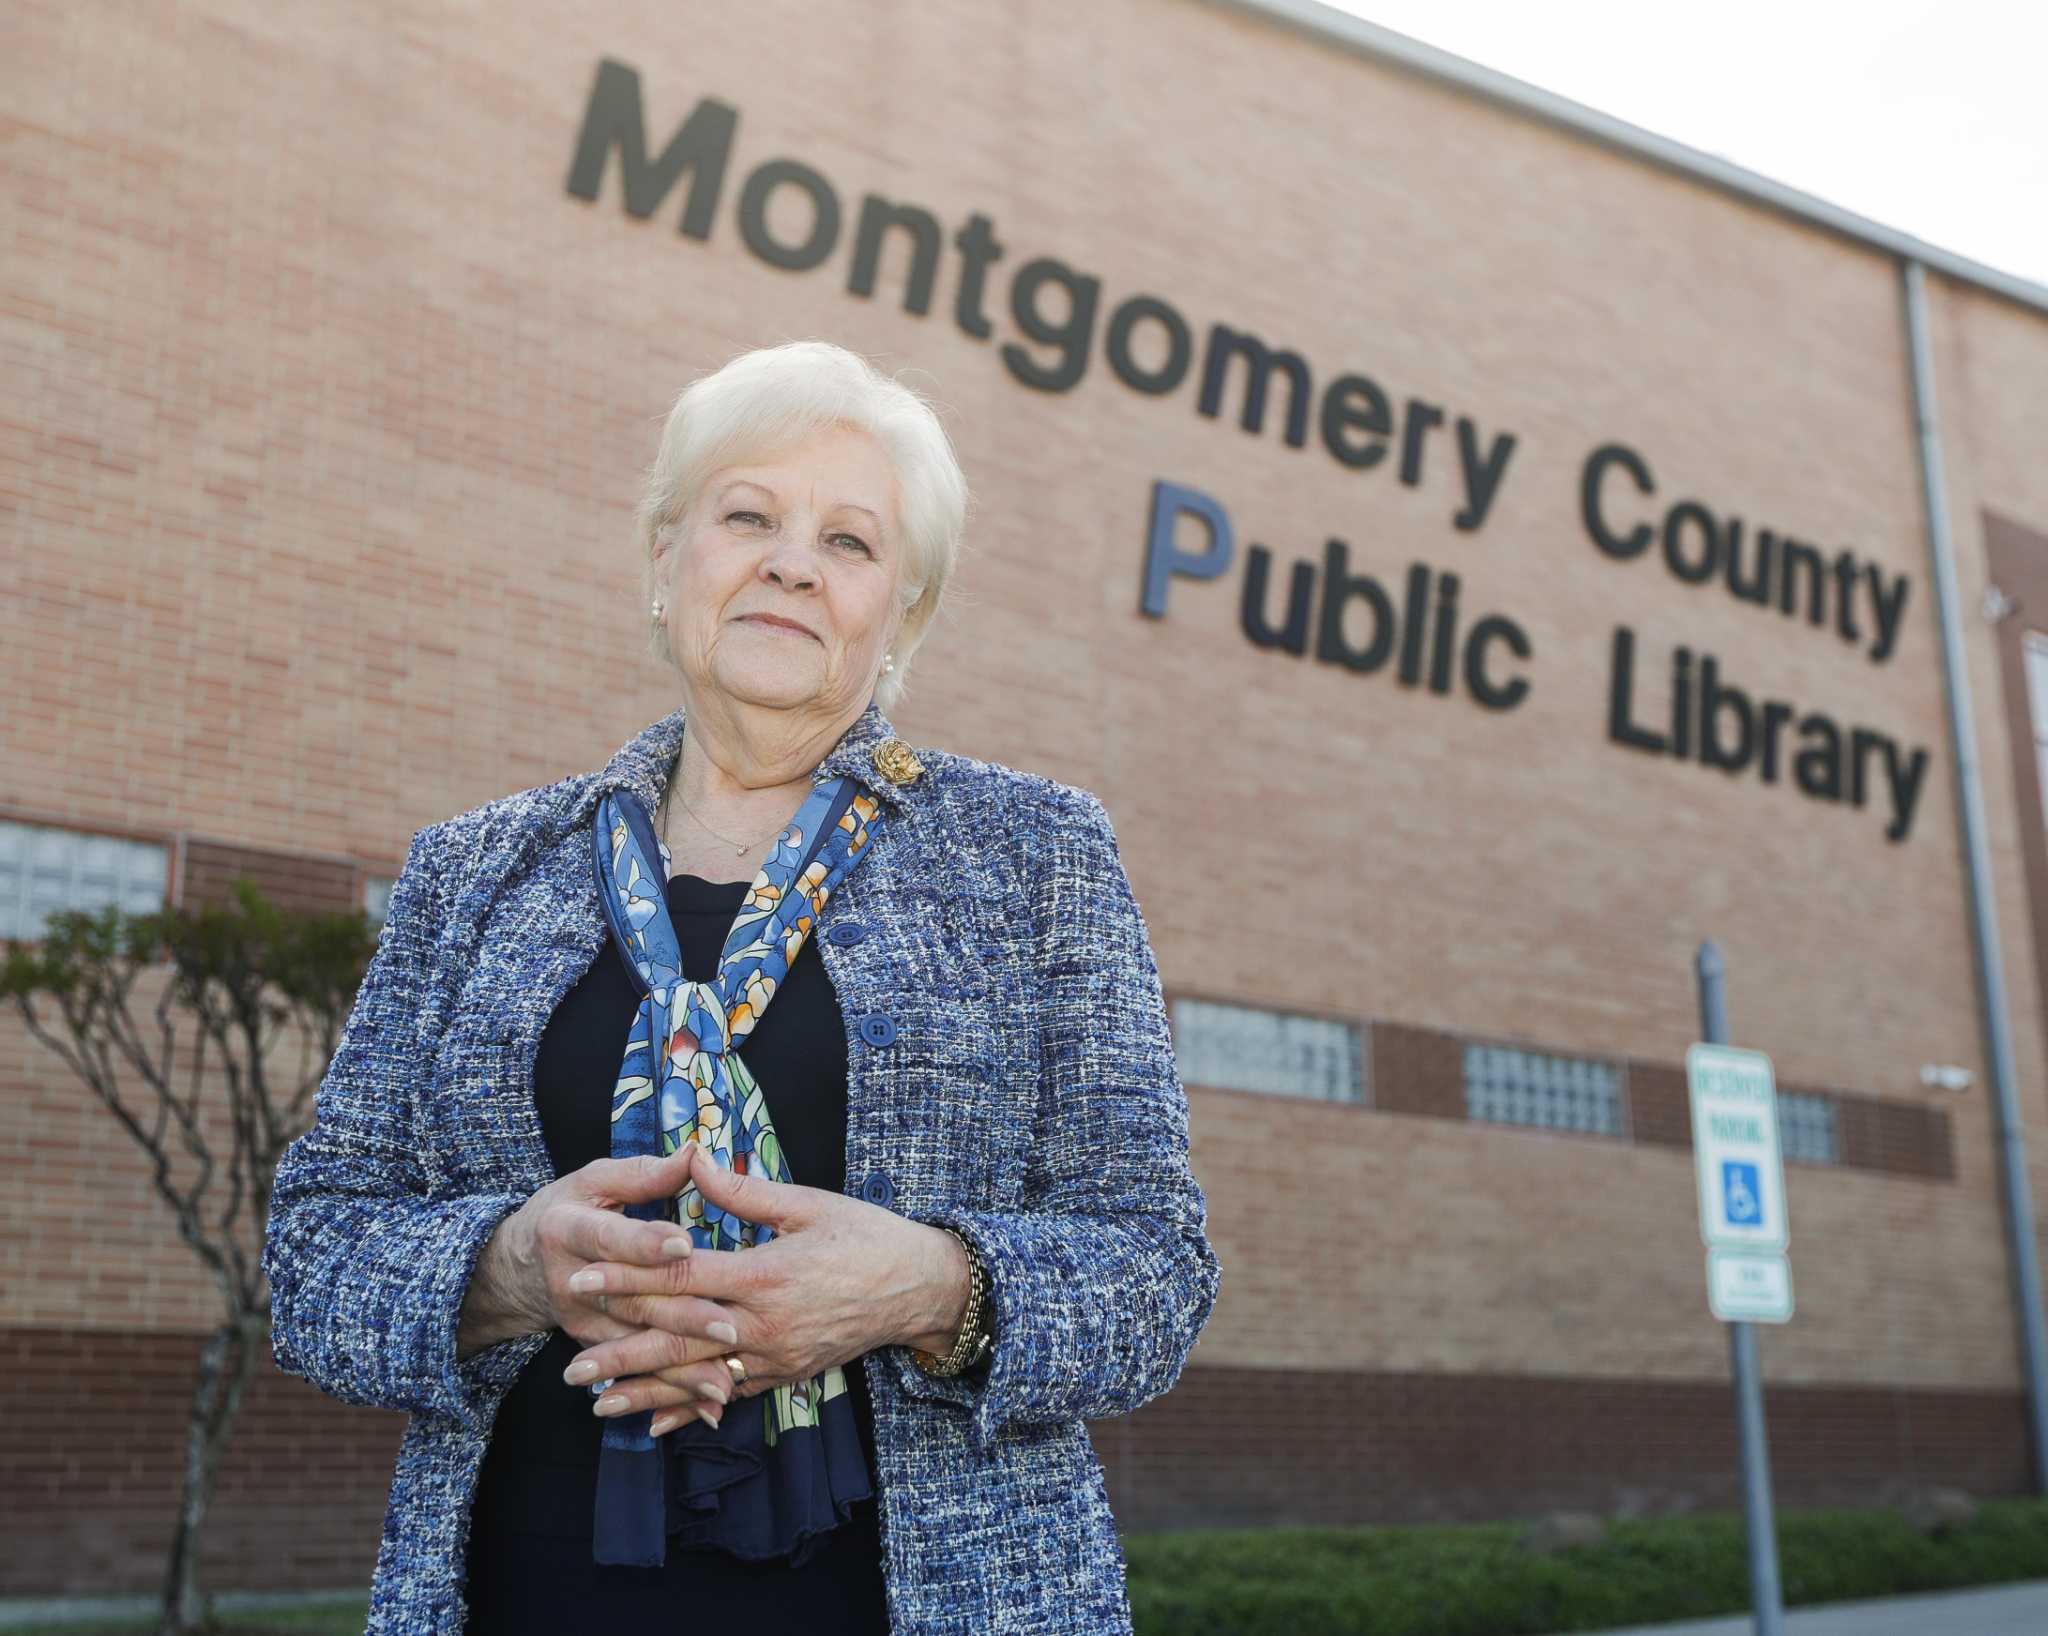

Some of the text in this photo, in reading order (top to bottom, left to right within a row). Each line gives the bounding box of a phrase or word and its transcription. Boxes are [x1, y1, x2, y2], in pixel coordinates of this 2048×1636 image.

[565, 55, 1911, 664] Montgomery County
[1136, 478, 1930, 846] Public Library
